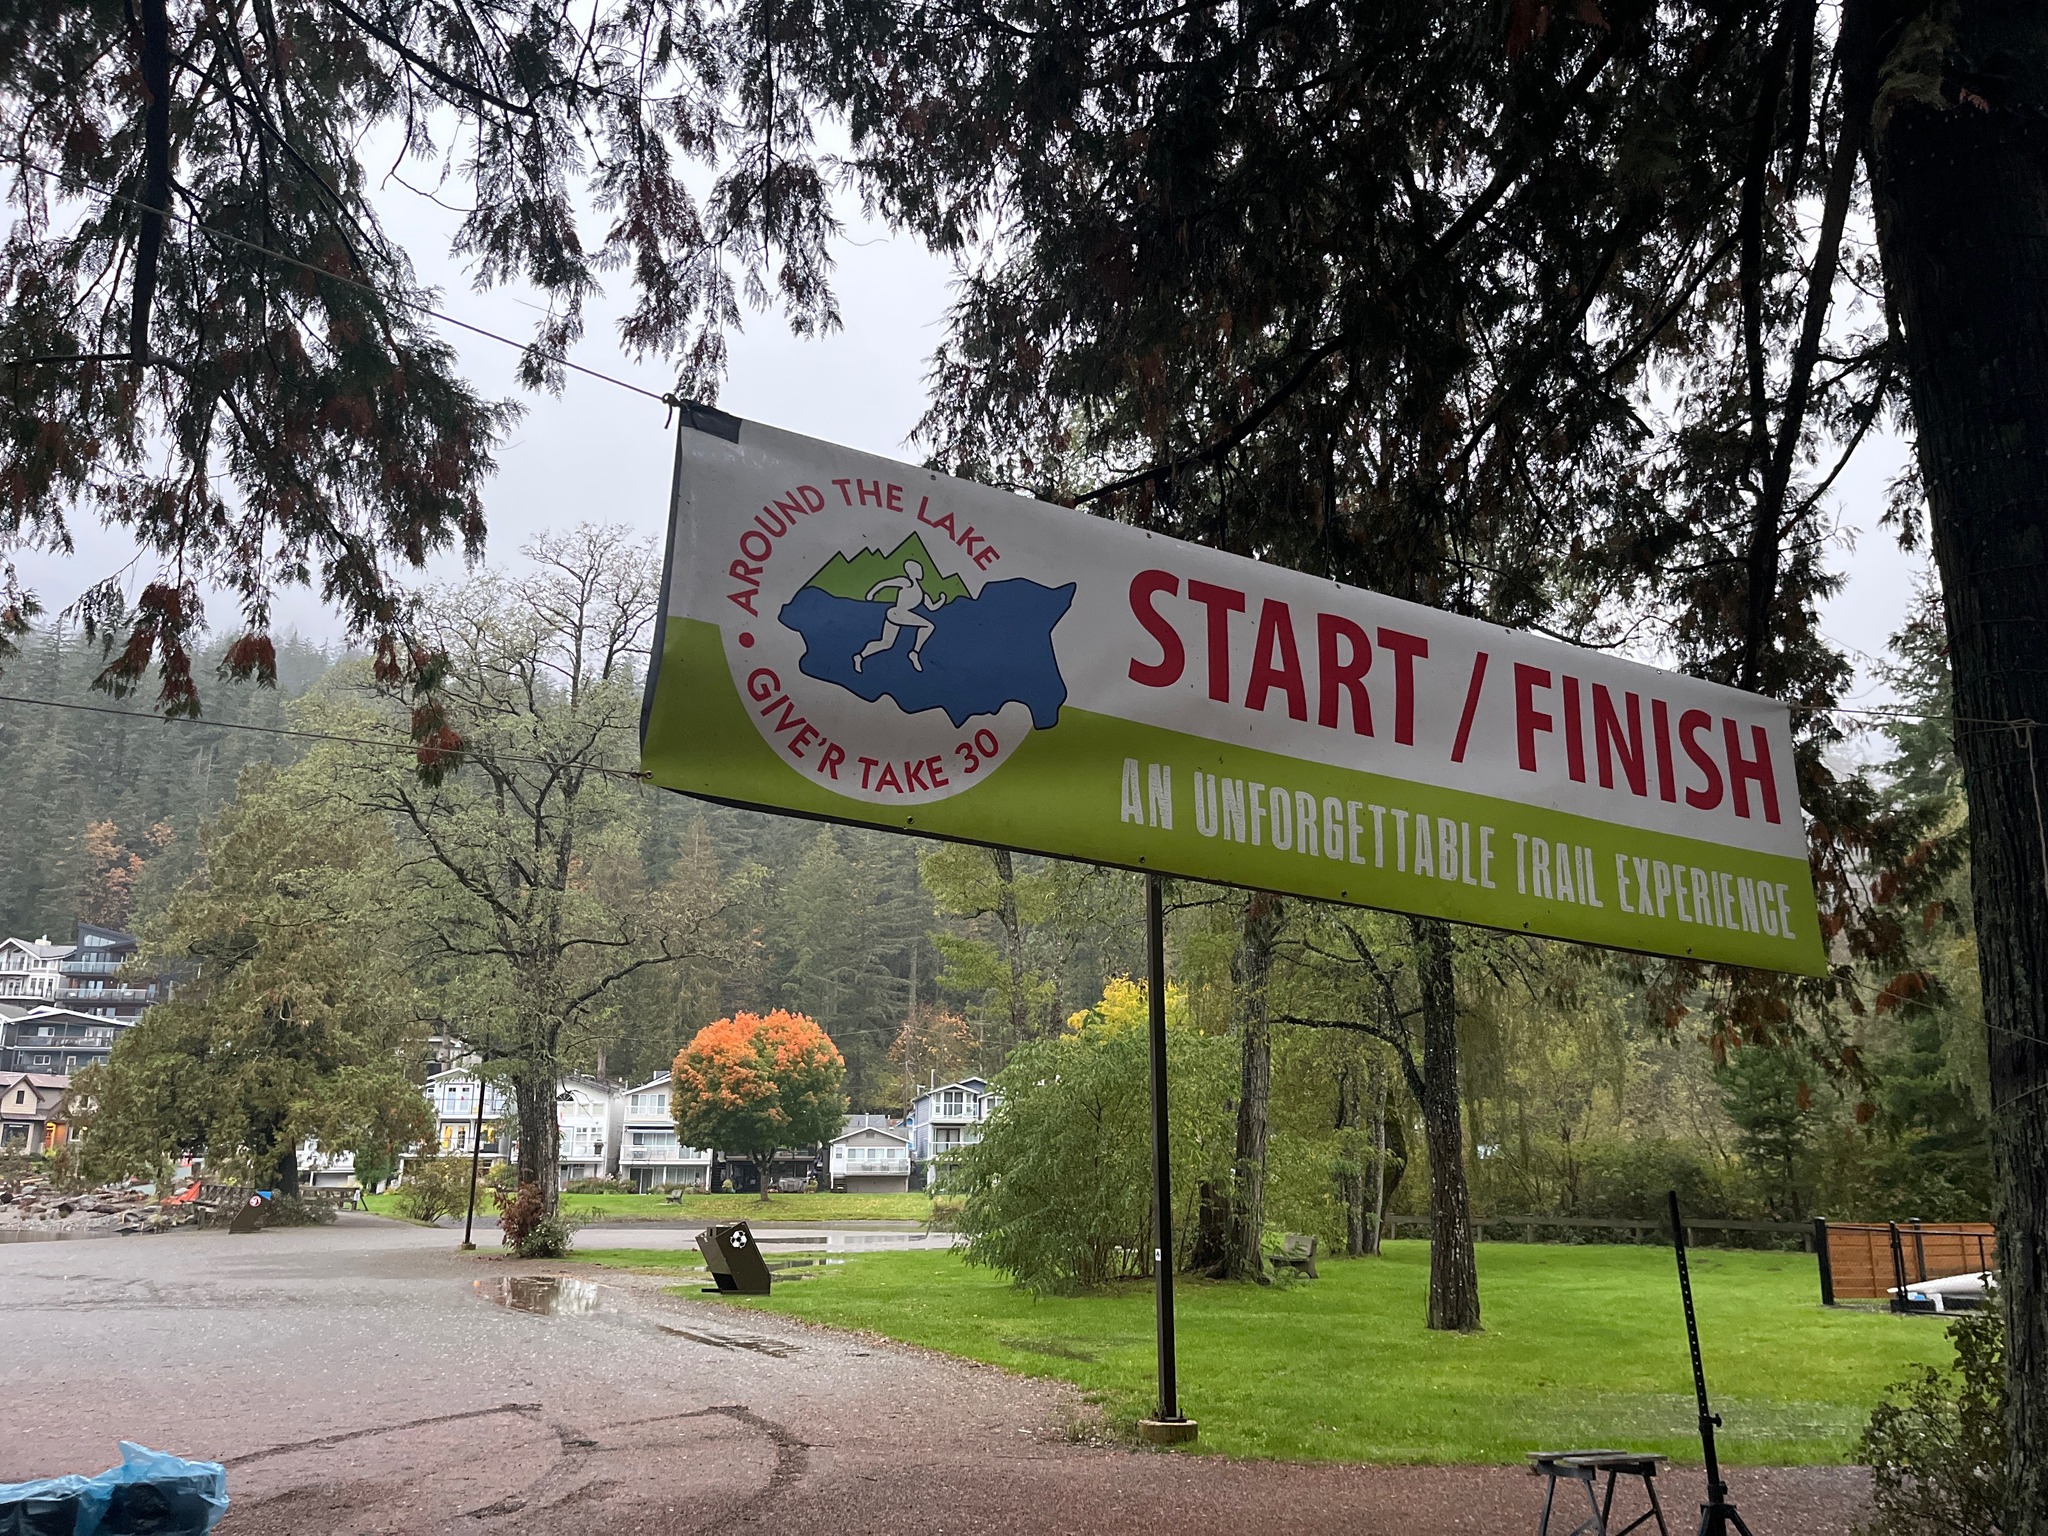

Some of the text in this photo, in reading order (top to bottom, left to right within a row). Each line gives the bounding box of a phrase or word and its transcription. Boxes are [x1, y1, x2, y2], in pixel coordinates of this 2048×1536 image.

[727, 479, 1000, 617] AROUND THE LAKE
[747, 667, 999, 794] GIVE'R TAKE 30
[1128, 569, 1782, 825] START / FINISH
[1120, 757, 1796, 941] AN UNFORGETTABLE TRAIL EXPERIENCE
